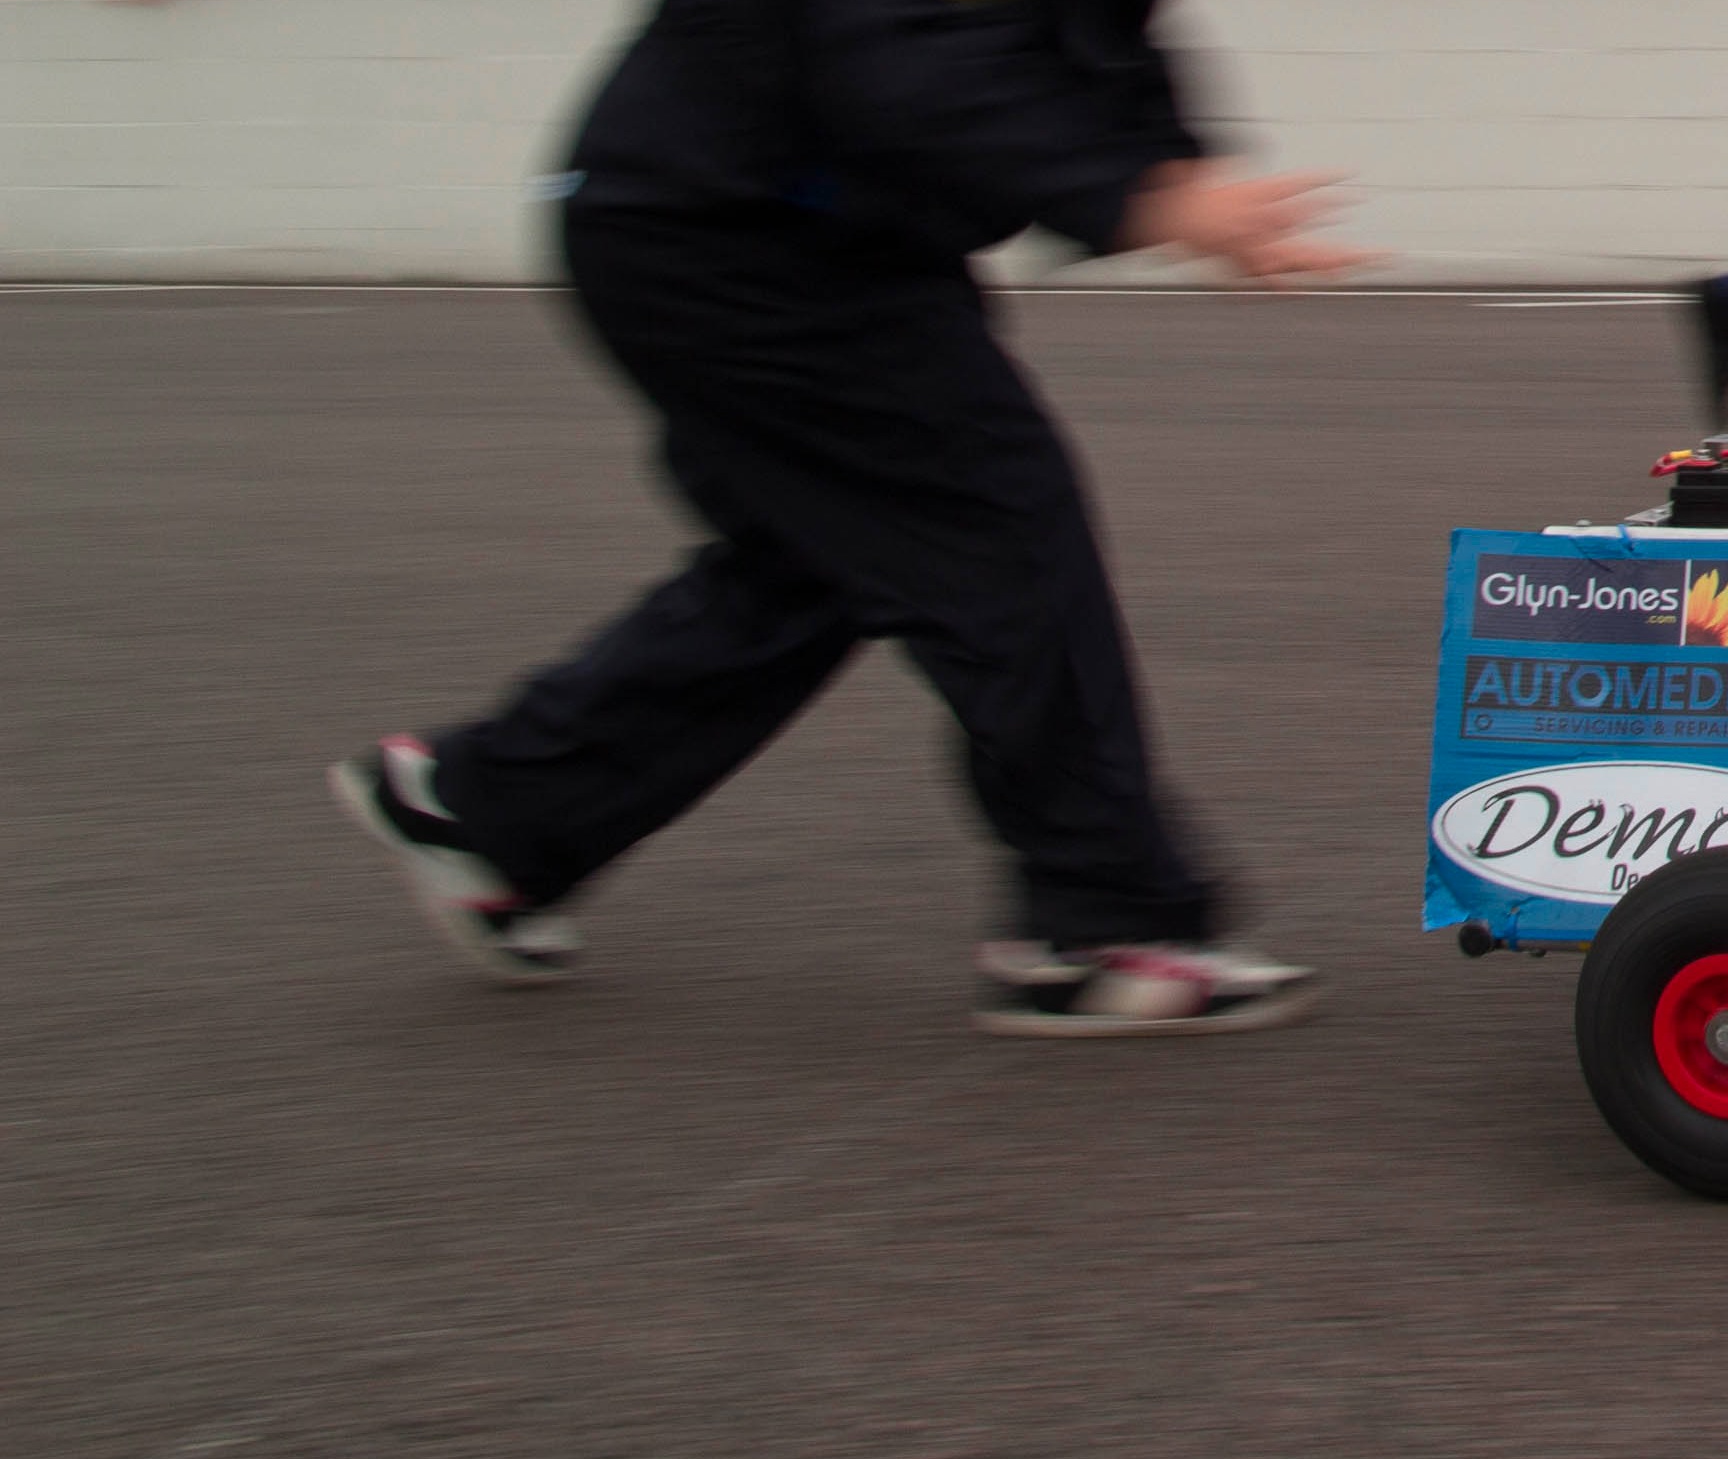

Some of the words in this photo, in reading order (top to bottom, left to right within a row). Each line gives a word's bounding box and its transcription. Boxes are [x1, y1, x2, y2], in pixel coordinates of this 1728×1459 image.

[1481, 573, 1679, 616] Glyn-Jones
[1646, 614, 1677, 625] .com
[1533, 716, 1644, 736] SERVICING
[1653, 719, 1666, 735] &
